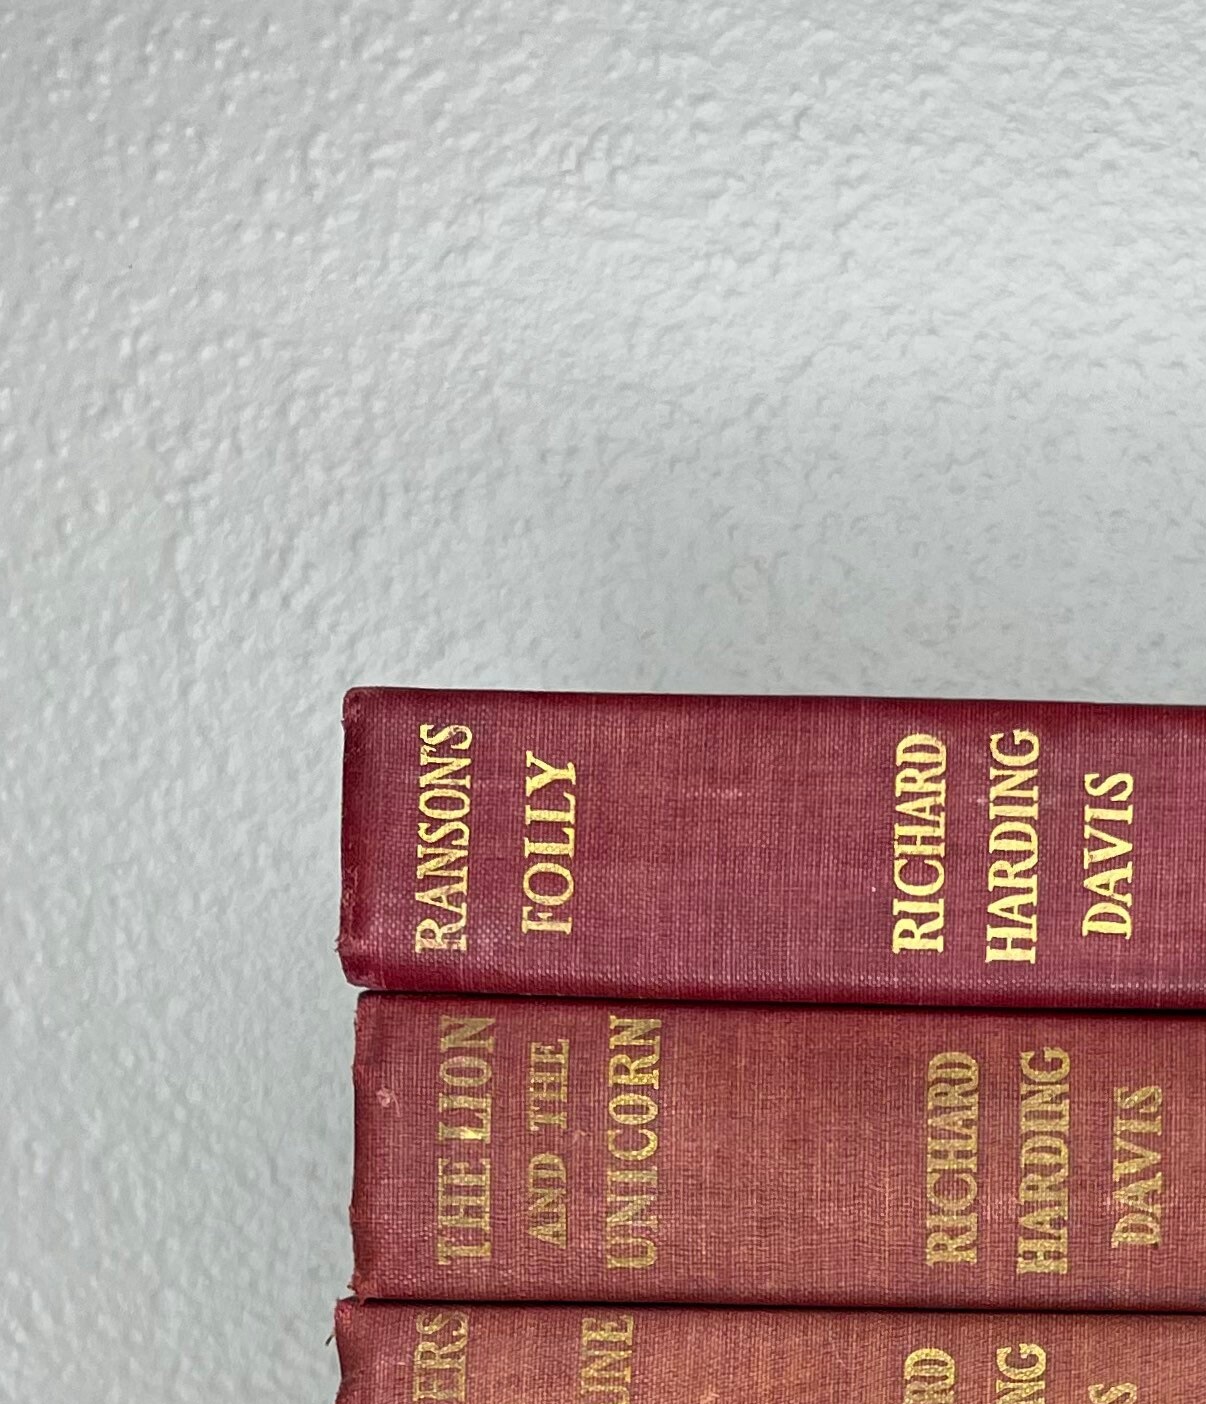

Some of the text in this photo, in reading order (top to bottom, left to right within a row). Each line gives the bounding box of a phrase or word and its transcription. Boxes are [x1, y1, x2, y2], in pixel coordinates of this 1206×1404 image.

[415, 723, 473, 955] RANSON'S
[522, 750, 577, 936] FOLLY
[893, 733, 946, 955] RICHARD
[985, 728, 1040, 964] HARDING
[1083, 771, 1134, 940] DAVIS
[436, 1015, 496, 1266] THE LION
[527, 1039, 570, 1247] AND THE
[607, 1015, 662, 1271] UNICORN
[925, 1050, 980, 1266] RICHARD
[1016, 1046, 1072, 1275] HARDING
[1112, 1085, 1163, 1249] DAVIS
